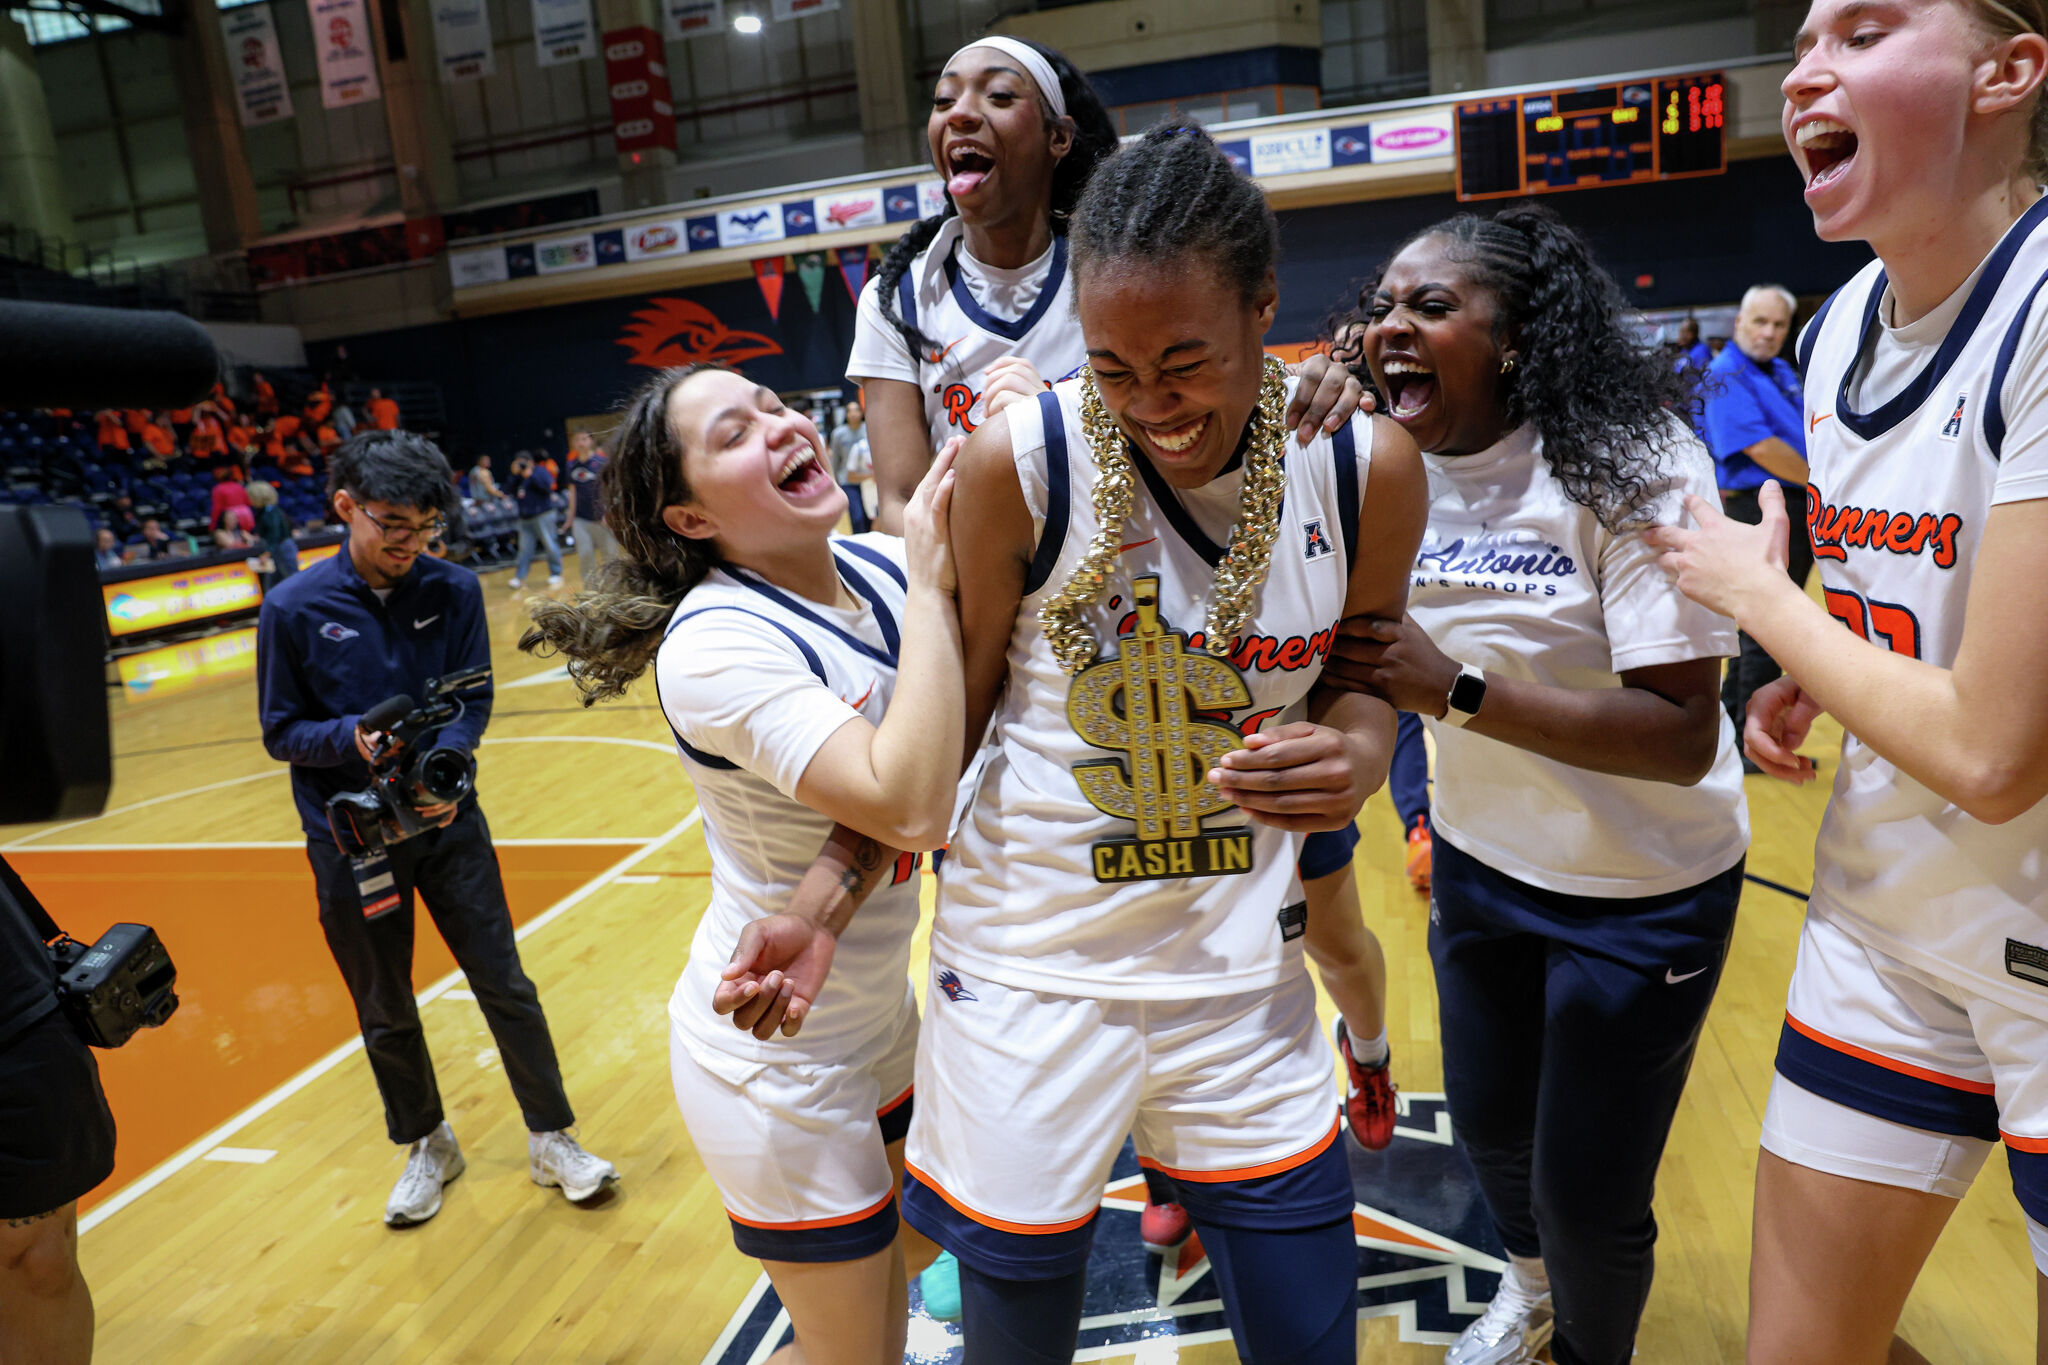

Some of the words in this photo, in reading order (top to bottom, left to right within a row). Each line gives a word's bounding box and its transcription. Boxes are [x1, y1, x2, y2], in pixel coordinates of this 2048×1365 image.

[1806, 482, 1963, 569] Runners
[1418, 538, 1577, 578] Antonio
[1093, 841, 1195, 879] CASH
[1207, 836, 1250, 871] IN
